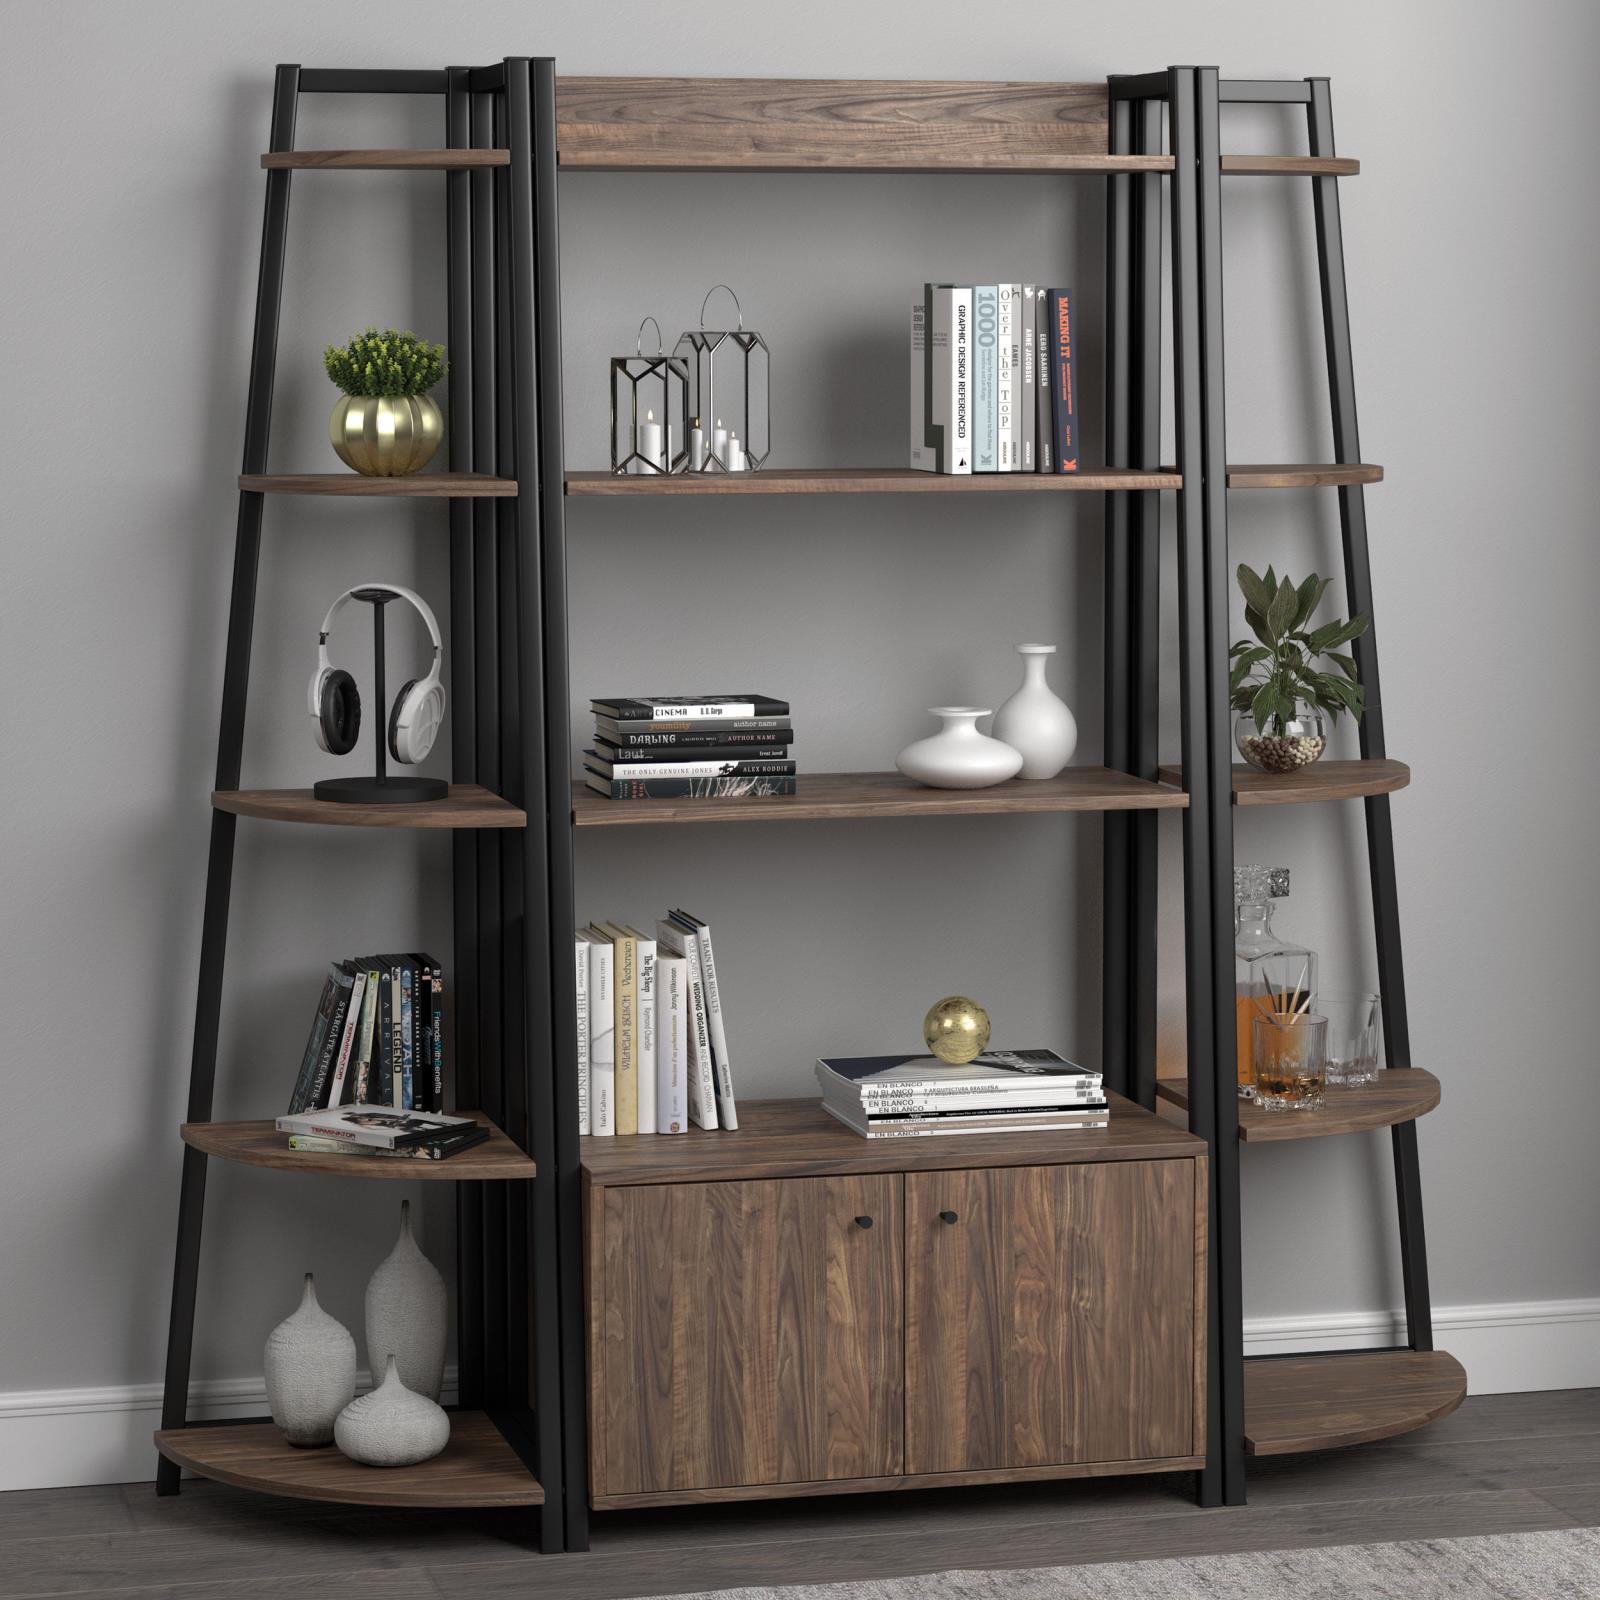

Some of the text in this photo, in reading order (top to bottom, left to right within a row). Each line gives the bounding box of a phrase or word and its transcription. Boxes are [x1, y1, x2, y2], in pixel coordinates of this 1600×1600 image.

[978, 292, 996, 348] 1000
[1059, 297, 1070, 344] MAKING
[1001, 289, 1010, 427] Over the Top
[1039, 333, 1048, 387] EERO SAARINEN
[1060, 345, 1071, 359] IT
[958, 304, 966, 438] GRAPHIC DESIGN REFERENCED
[655, 708, 688, 717] CINEMA
[733, 720, 757, 728] author
[629, 733, 676, 745] DARLING
[727, 734, 755, 742] AUTHOR
[641, 966, 653, 977] Big
[644, 954, 653, 966] The
[702, 938, 720, 1014] TRAIN FOR RESULTS
[641, 977, 653, 993] Sleep
[670, 967, 678, 993] Wilkinson
[692, 981, 703, 1011] WEDDING
[695, 1011, 707, 1047] ORGANIZER
[312, 1000, 346, 1098] STARGATE ATLANTIS
[336, 1022, 354, 1080] TERMINATOR
[383, 1001, 391, 1093] ARRIVAL
[393, 1022, 402, 1074] LEGEND
[577, 990, 586, 1125] THE PORTER PRINCIPLES
[622, 1029, 631, 1072] WILHELM
[881, 1088, 913, 1096] BLANCO
[881, 1099, 914, 1107] BLANCO
[891, 1105, 924, 1113] BLANCO
[311, 1127, 356, 1141] TERMINATOR
